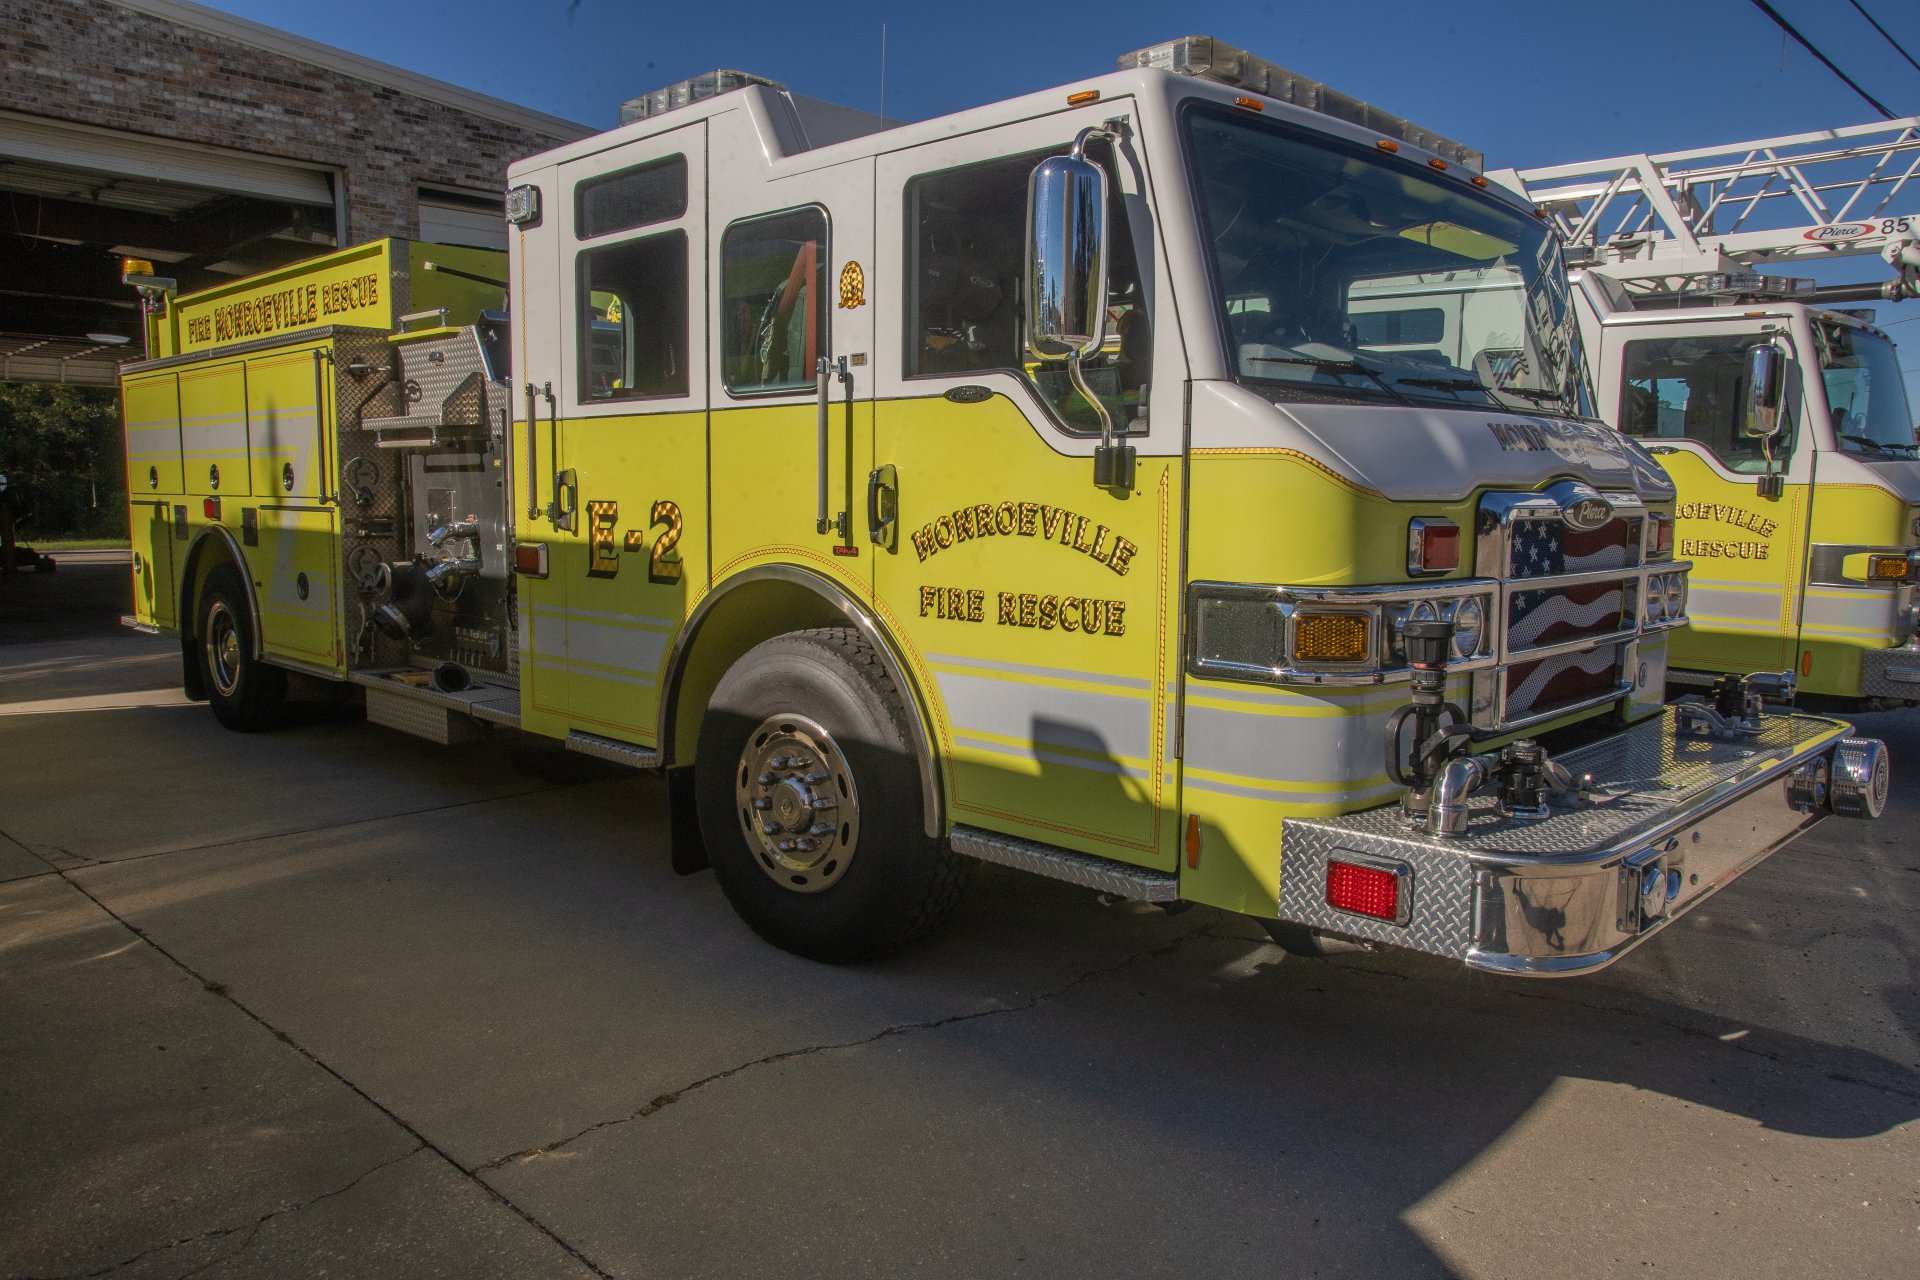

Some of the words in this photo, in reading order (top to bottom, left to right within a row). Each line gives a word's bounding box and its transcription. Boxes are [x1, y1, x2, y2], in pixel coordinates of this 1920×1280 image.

[1818, 226, 1858, 239] Pierce
[188, 314, 212, 344] FIRE
[214, 284, 318, 342] MONROEVILLE
[322, 273, 378, 316] RESCUE
[1578, 500, 1607, 523] Pierce
[585, 500, 684, 585] E-2
[911, 501, 1138, 577] MONROEVILLE
[1681, 539, 1769, 560] RESCUE
[919, 585, 985, 622] FIRE
[997, 591, 1126, 636] RESCUE
